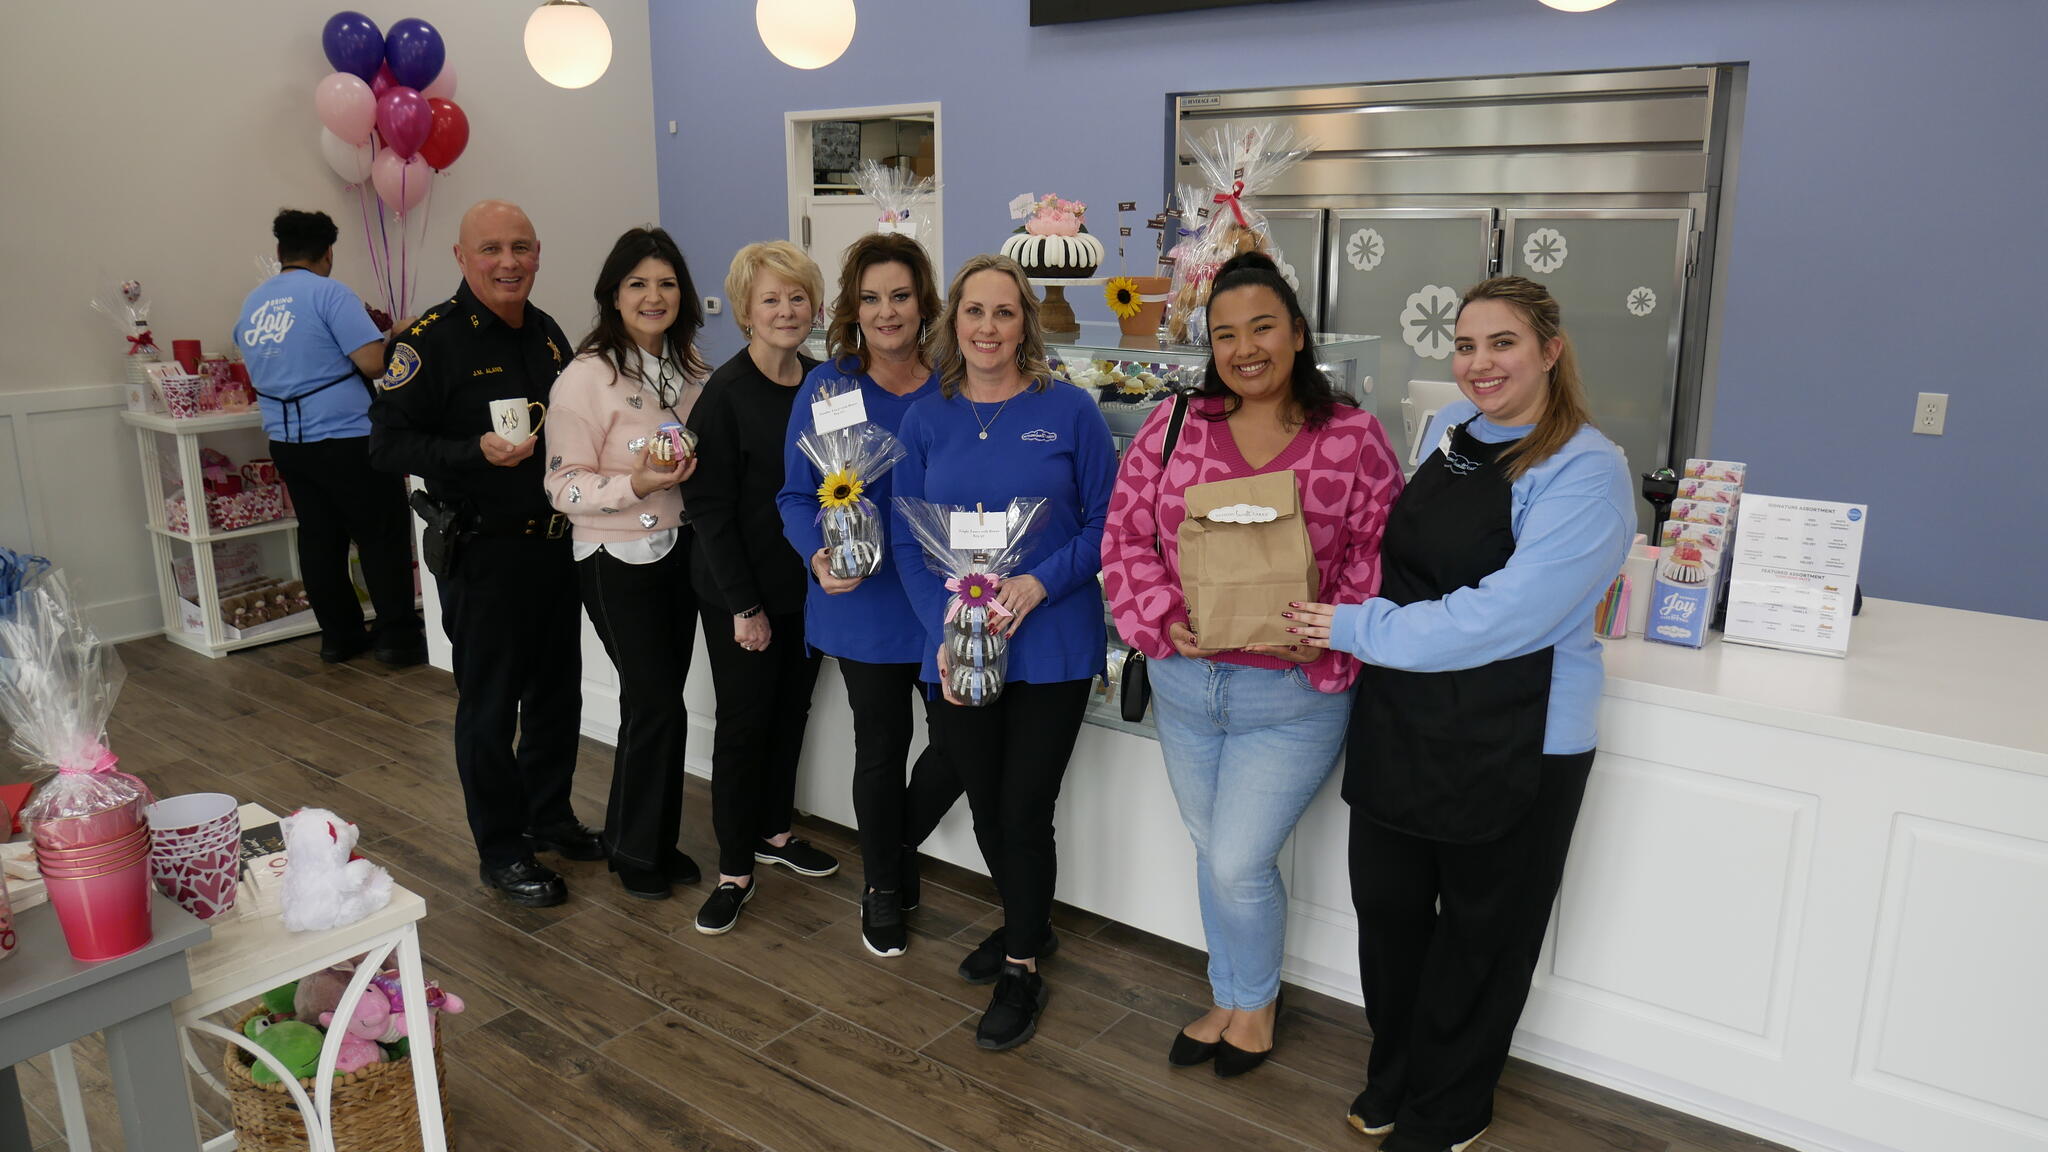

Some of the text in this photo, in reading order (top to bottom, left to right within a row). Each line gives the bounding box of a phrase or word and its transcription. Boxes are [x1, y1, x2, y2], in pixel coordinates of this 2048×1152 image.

[270, 296, 293, 306] BRING
[273, 304, 285, 312] THE
[244, 300, 295, 347] Joy
[1768, 502, 1836, 514] SIGNATURE ASSORTMENT
[1761, 568, 1788, 576] FEATURED
[1789, 570, 1825, 579] ASSORTMENT
[1659, 592, 1697, 618] Joy
